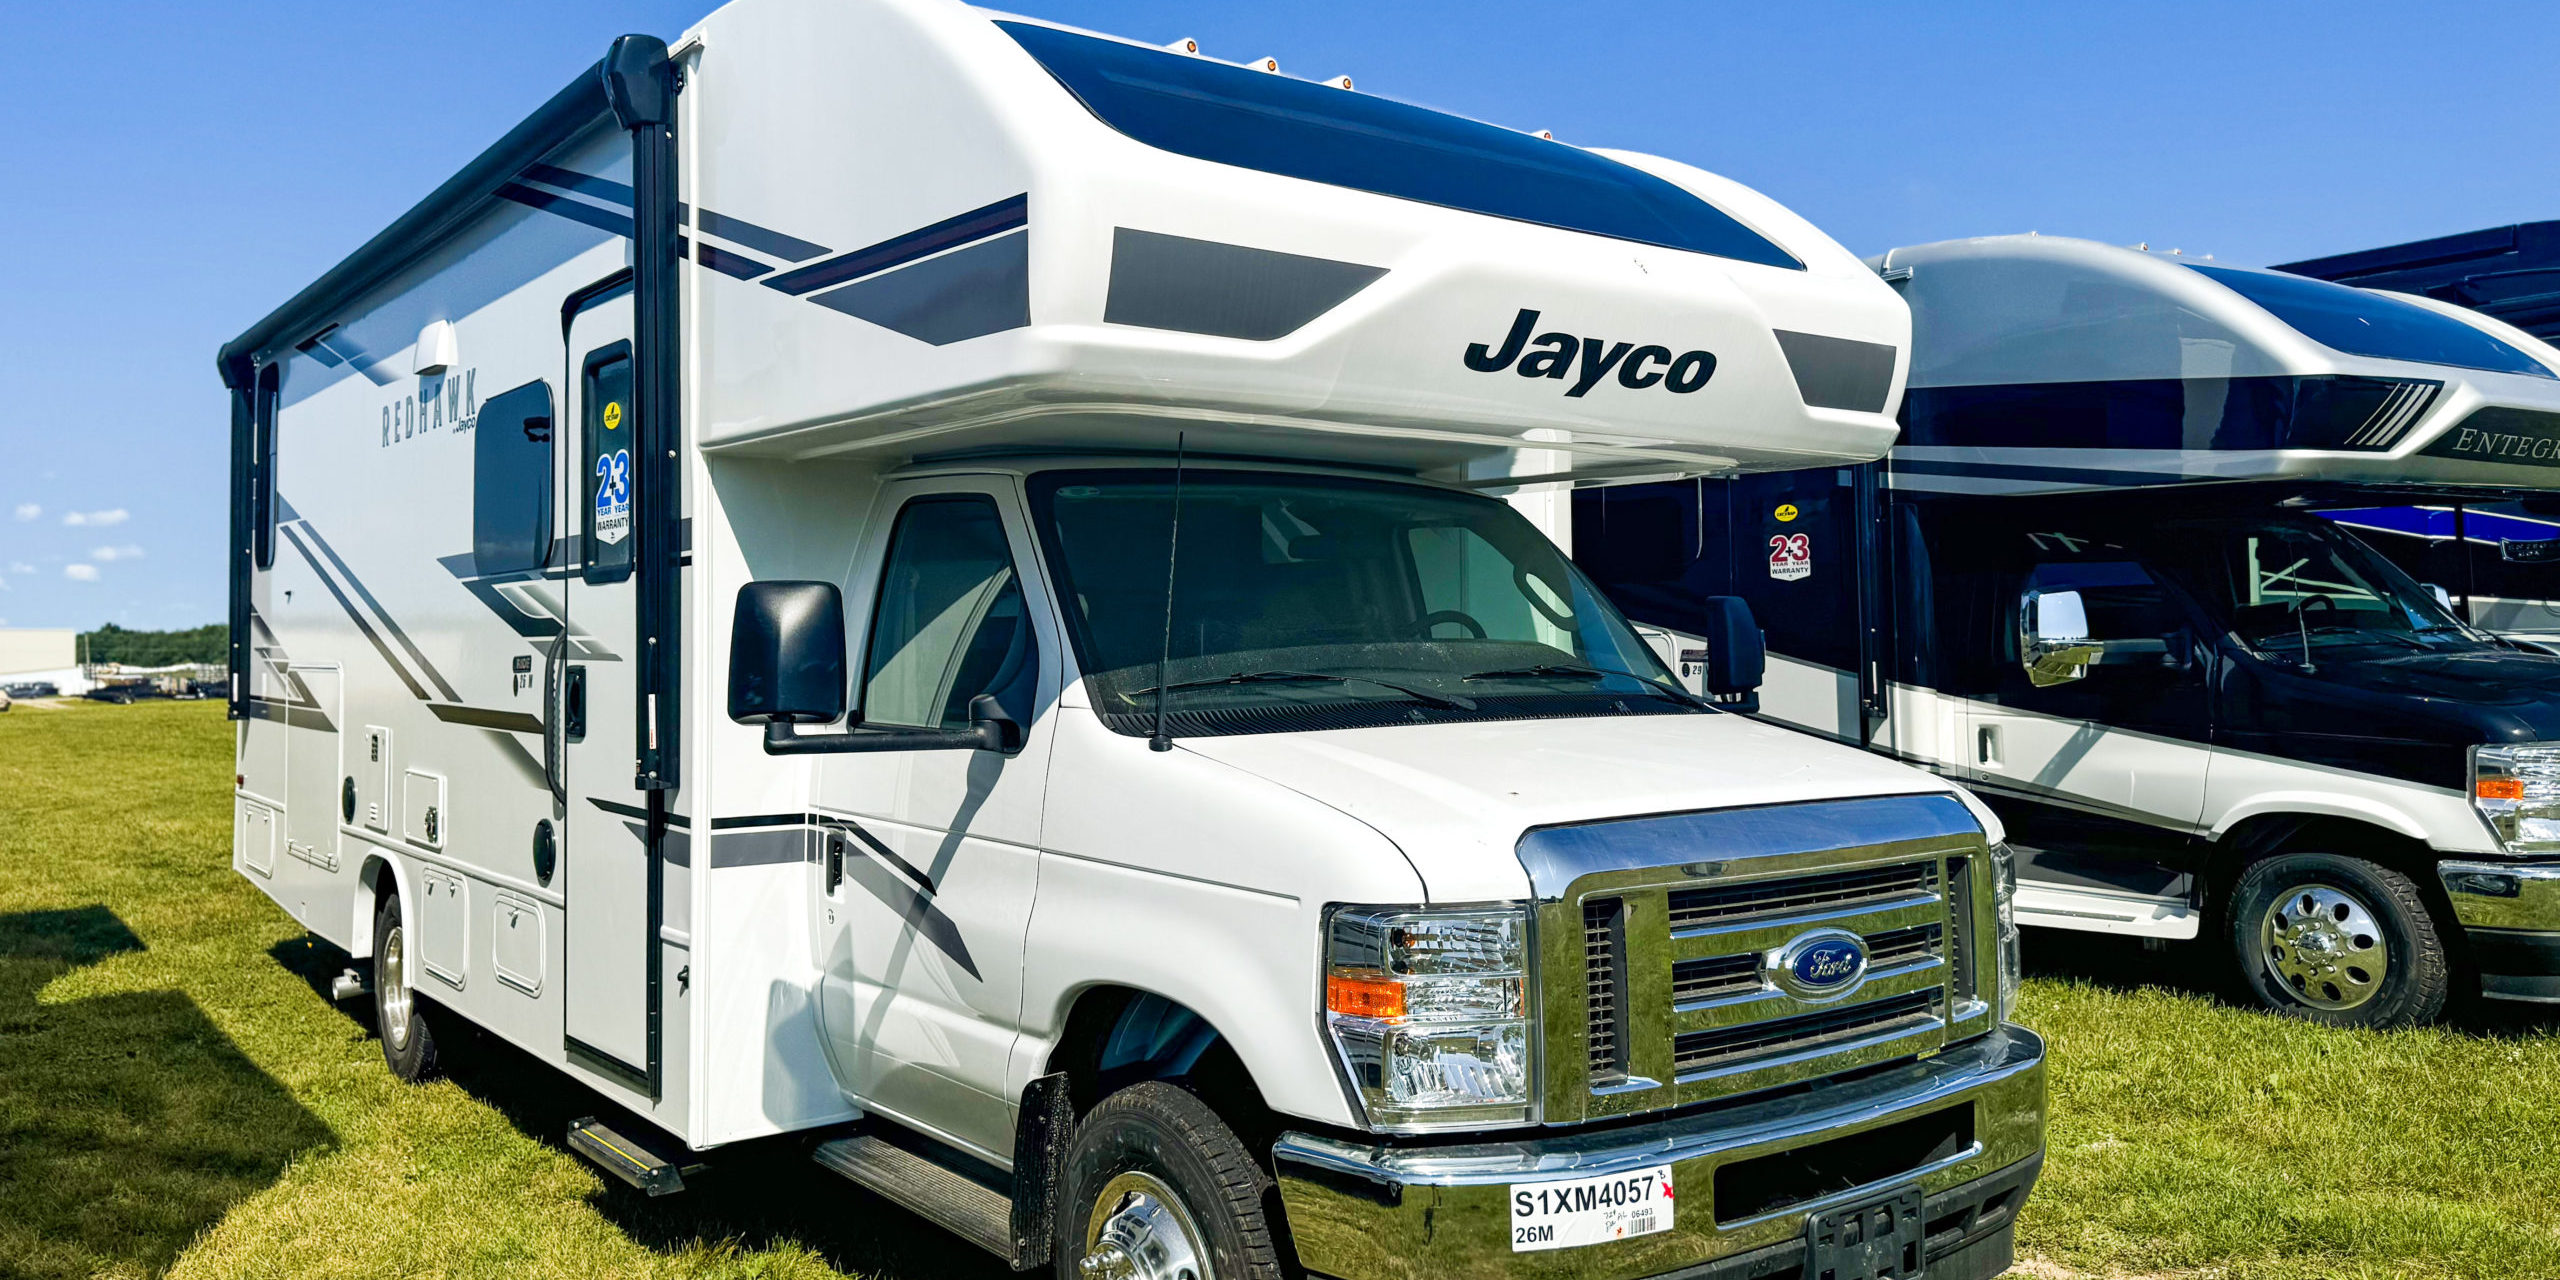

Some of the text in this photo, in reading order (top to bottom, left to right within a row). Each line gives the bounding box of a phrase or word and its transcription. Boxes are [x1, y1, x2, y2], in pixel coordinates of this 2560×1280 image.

[1463, 308, 1717, 398] Jayco
[382, 367, 477, 448] REDHAWK
[597, 502, 630, 517] YEAR YEAR
[597, 517, 629, 532] WARRANTY
[1772, 567, 1809, 575] WARRANTY
[1810, 949, 1852, 979] Ford
[1515, 1174, 1654, 1218] S1XM4057
[1515, 1224, 1554, 1244] 26M
